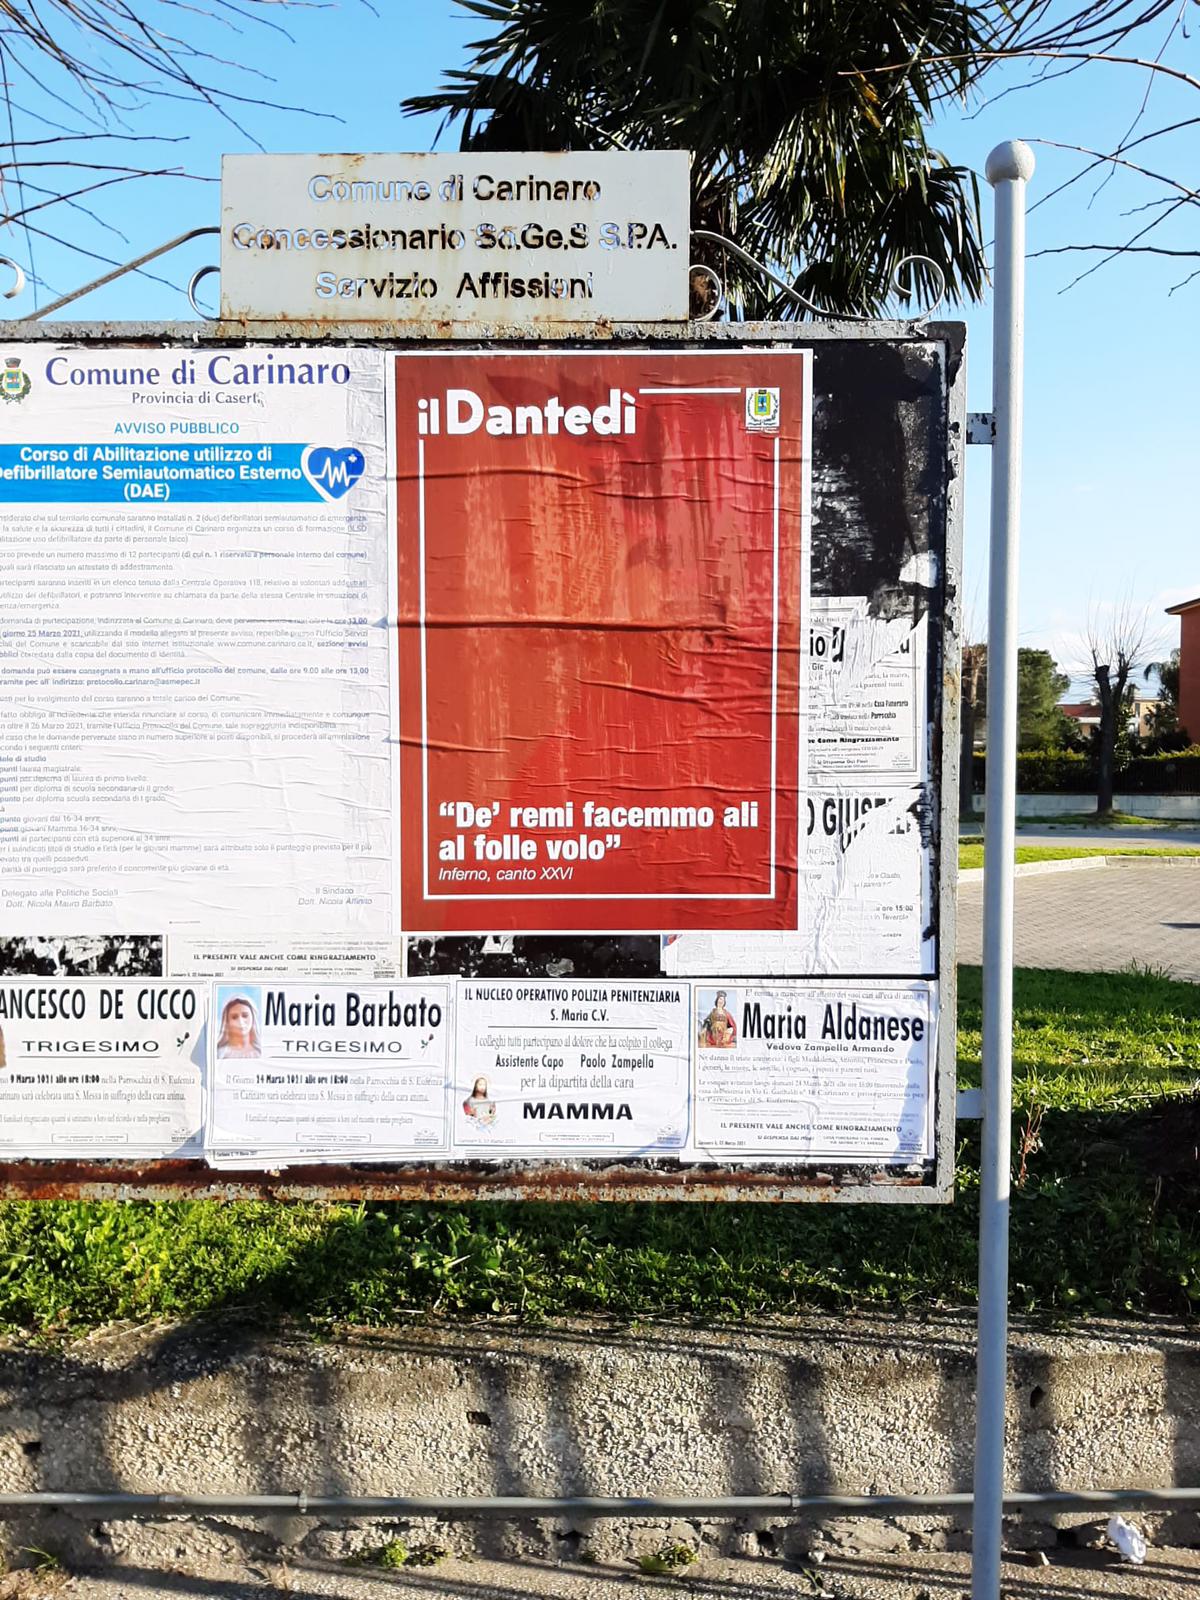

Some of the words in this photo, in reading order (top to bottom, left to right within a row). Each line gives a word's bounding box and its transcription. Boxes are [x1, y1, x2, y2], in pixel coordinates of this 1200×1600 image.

[308, 175, 431, 202] Comune
[438, 175, 464, 202] di
[473, 175, 601, 202] Carinaro
[232, 222, 465, 251] Concessionario
[316, 271, 437, 298] Servizio
[457, 271, 593, 298] Affissioni
[45, 357, 160, 386] Comune
[172, 360, 196, 385] di
[208, 354, 350, 385] Carinaro
[132, 392, 194, 404] Provincia
[199, 392, 211, 404] di
[418, 399, 439, 434] il
[446, 389, 636, 435] Dantedì
[114, 422, 166, 434] AVVISO
[170, 422, 239, 434] PUBBLICO
[20, 447, 68, 462] Corso
[73, 447, 88, 462] di
[93, 447, 189, 462] Abilitazione
[194, 447, 249, 462] utilizzo
[256, 447, 272, 462] di
[102, 465, 235, 480] Semiautomatico
[239, 465, 301, 480] Esterno
[124, 483, 170, 500] (DAE)
[510, 801, 573, 827] remi
[583, 802, 714, 827] facemmo
[724, 801, 758, 827] ali
[439, 836, 464, 860] al
[474, 835, 536, 860] folle
[439, 868, 490, 882] Inferno,
[496, 868, 536, 881] canto
[540, 868, 573, 880] XXVI
[101, 989, 123, 1019] DE
[138, 989, 195, 1019] CICCO
[465, 989, 472, 1000] IL
[477, 989, 512, 1000] NUCLEO
[516, 989, 568, 1001] OPERATIVO
[572, 990, 607, 1002] POLIZIA
[611, 990, 680, 1003] PENITENZIARIA
[265, 992, 335, 1026] Maria
[346, 991, 442, 1027] Barbato
[551, 1009, 558, 1021] S.
[562, 1009, 588, 1021] Maria
[592, 1009, 609, 1021] C.V.
[742, 1003, 806, 1039] Maria
[822, 1003, 924, 1042] Aldanese
[22, 1040, 159, 1052] TRIGESIMO
[282, 1040, 402, 1052] TRIGESIMO
[479, 1035, 505, 1050] colleghi
[507, 1035, 521, 1047] tutti
[524, 1035, 562, 1050] partecipano
[564, 1036, 570, 1047] al
[572, 1036, 593, 1048] dolore
[595, 1036, 607, 1048] che
[608, 1036, 616, 1048] ha
[618, 1037, 641, 1050] colpito
[649, 1037, 672, 1051] collega
[767, 1043, 801, 1051] Vedova
[804, 1043, 849, 1053] Zampella
[496, 1055, 539, 1068] Assistente
[542, 1055, 564, 1070] Capo
[580, 1054, 606, 1068] Paolo
[612, 1055, 654, 1071] Zampella
[521, 1077, 535, 1091] per
[538, 1075, 546, 1087] la
[549, 1075, 587, 1091] dipartita
[590, 1075, 612, 1088] della
[615, 1078, 634, 1088] cara
[523, 1102, 633, 1120] MAMMA
